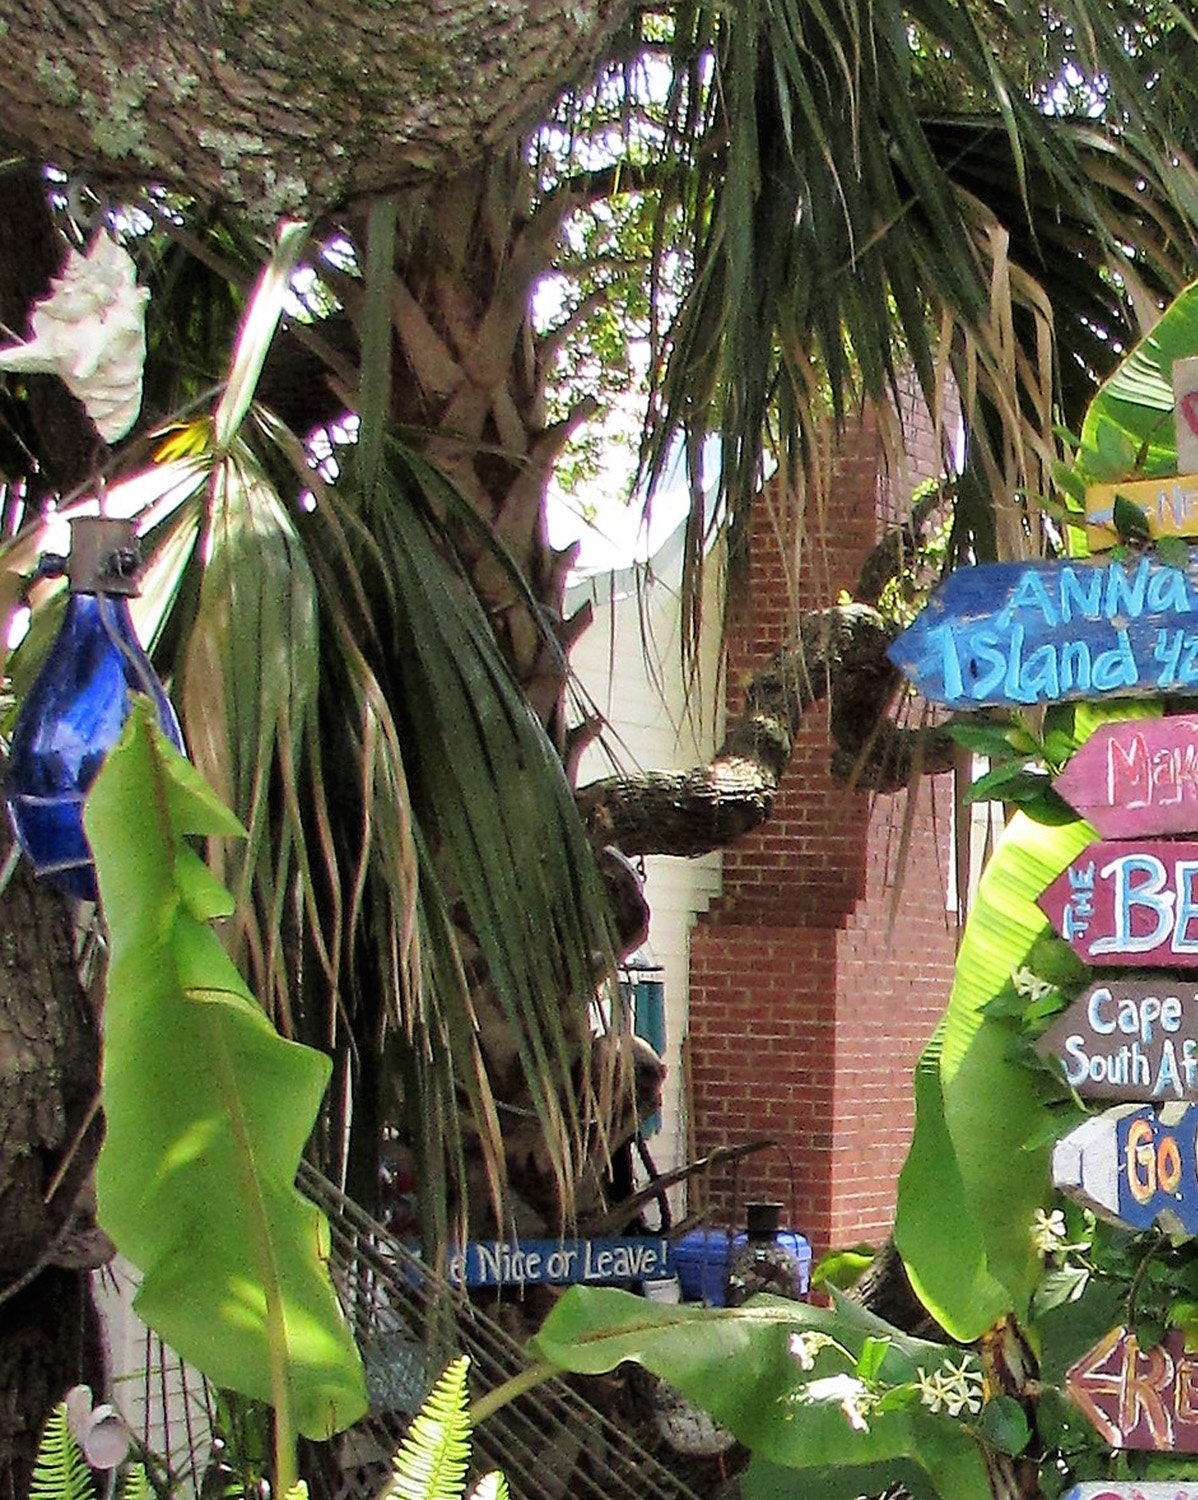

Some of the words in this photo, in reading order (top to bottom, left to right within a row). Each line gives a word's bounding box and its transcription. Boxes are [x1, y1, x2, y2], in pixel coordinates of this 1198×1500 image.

[935, 622, 1140, 702] Island
[1087, 988, 1184, 1043] Cape
[1062, 1035, 1151, 1087] South
[477, 1241, 541, 1285] Nice
[547, 1250, 578, 1279] or
[583, 1240, 670, 1280] Leave!
